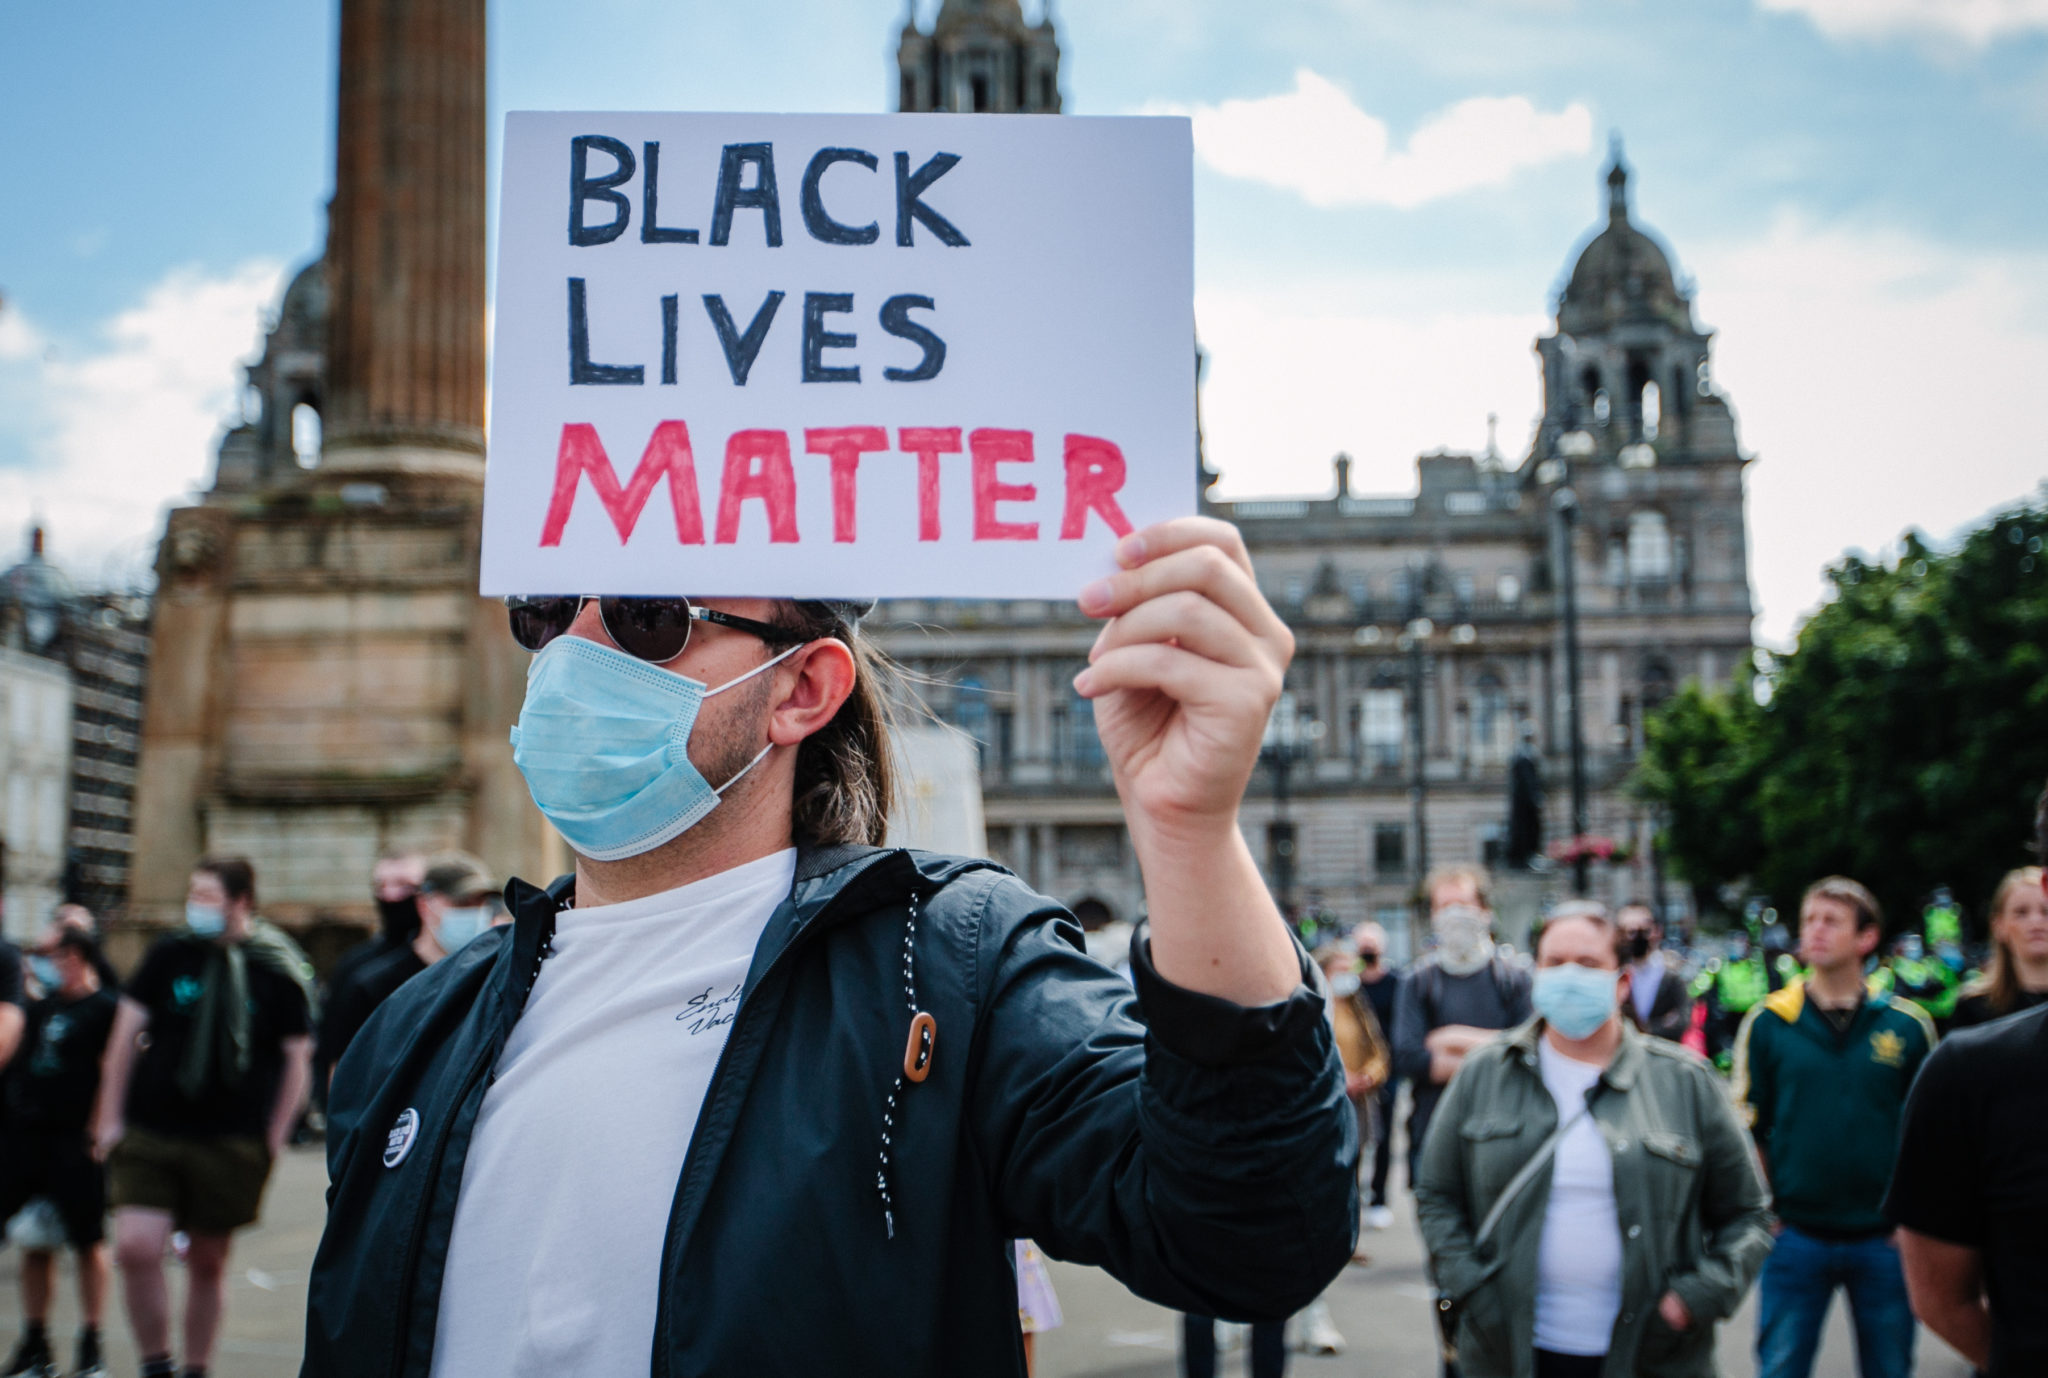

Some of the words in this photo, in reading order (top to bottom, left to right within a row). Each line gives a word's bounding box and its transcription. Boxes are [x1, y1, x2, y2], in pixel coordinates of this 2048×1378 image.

[567, 135, 971, 247] BLACK
[567, 277, 947, 386] LIVES
[539, 419, 1136, 547] MATTER
[675, 984, 742, 1021] Endl
[687, 1006, 735, 1035] Vac
